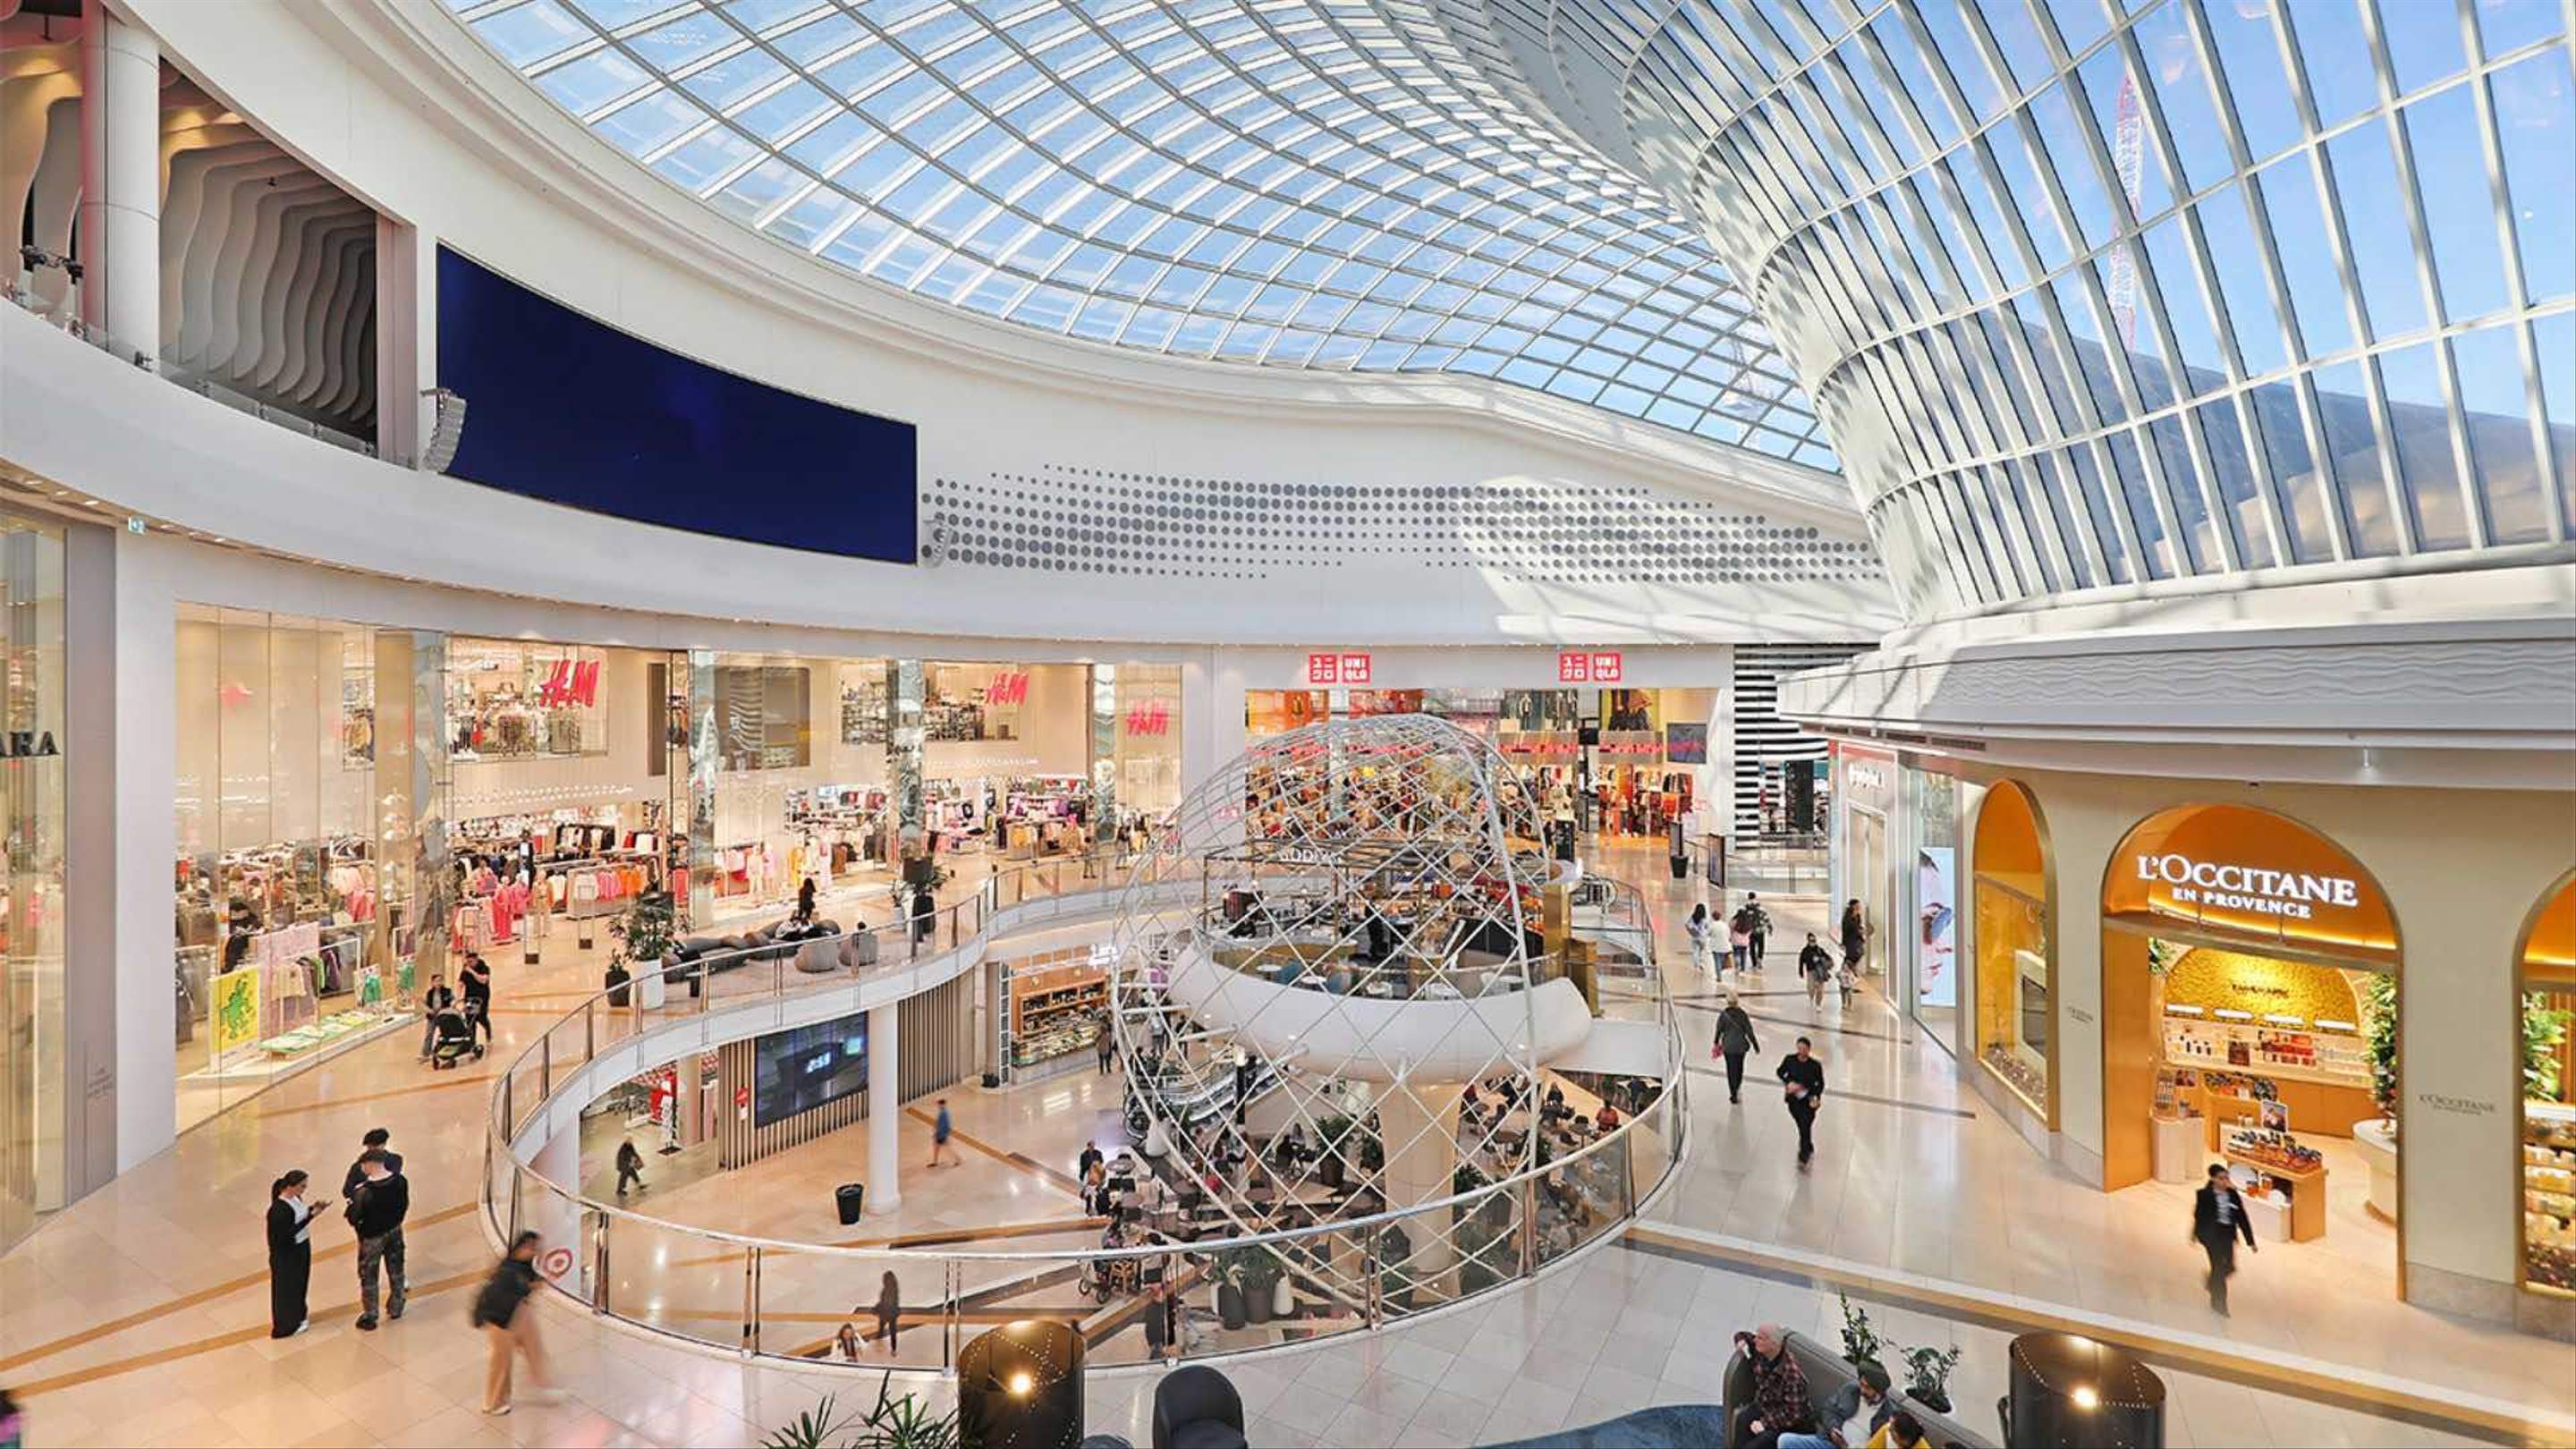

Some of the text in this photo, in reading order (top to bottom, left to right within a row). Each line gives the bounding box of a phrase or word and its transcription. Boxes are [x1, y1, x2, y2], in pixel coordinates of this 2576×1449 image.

[538, 659, 600, 708] H&M
[987, 673, 1029, 706] H&M
[0, 731, 60, 757] RA
[2137, 854, 2359, 907] L'OCCITANE
[2172, 887, 2311, 919] EN PROVENCE
